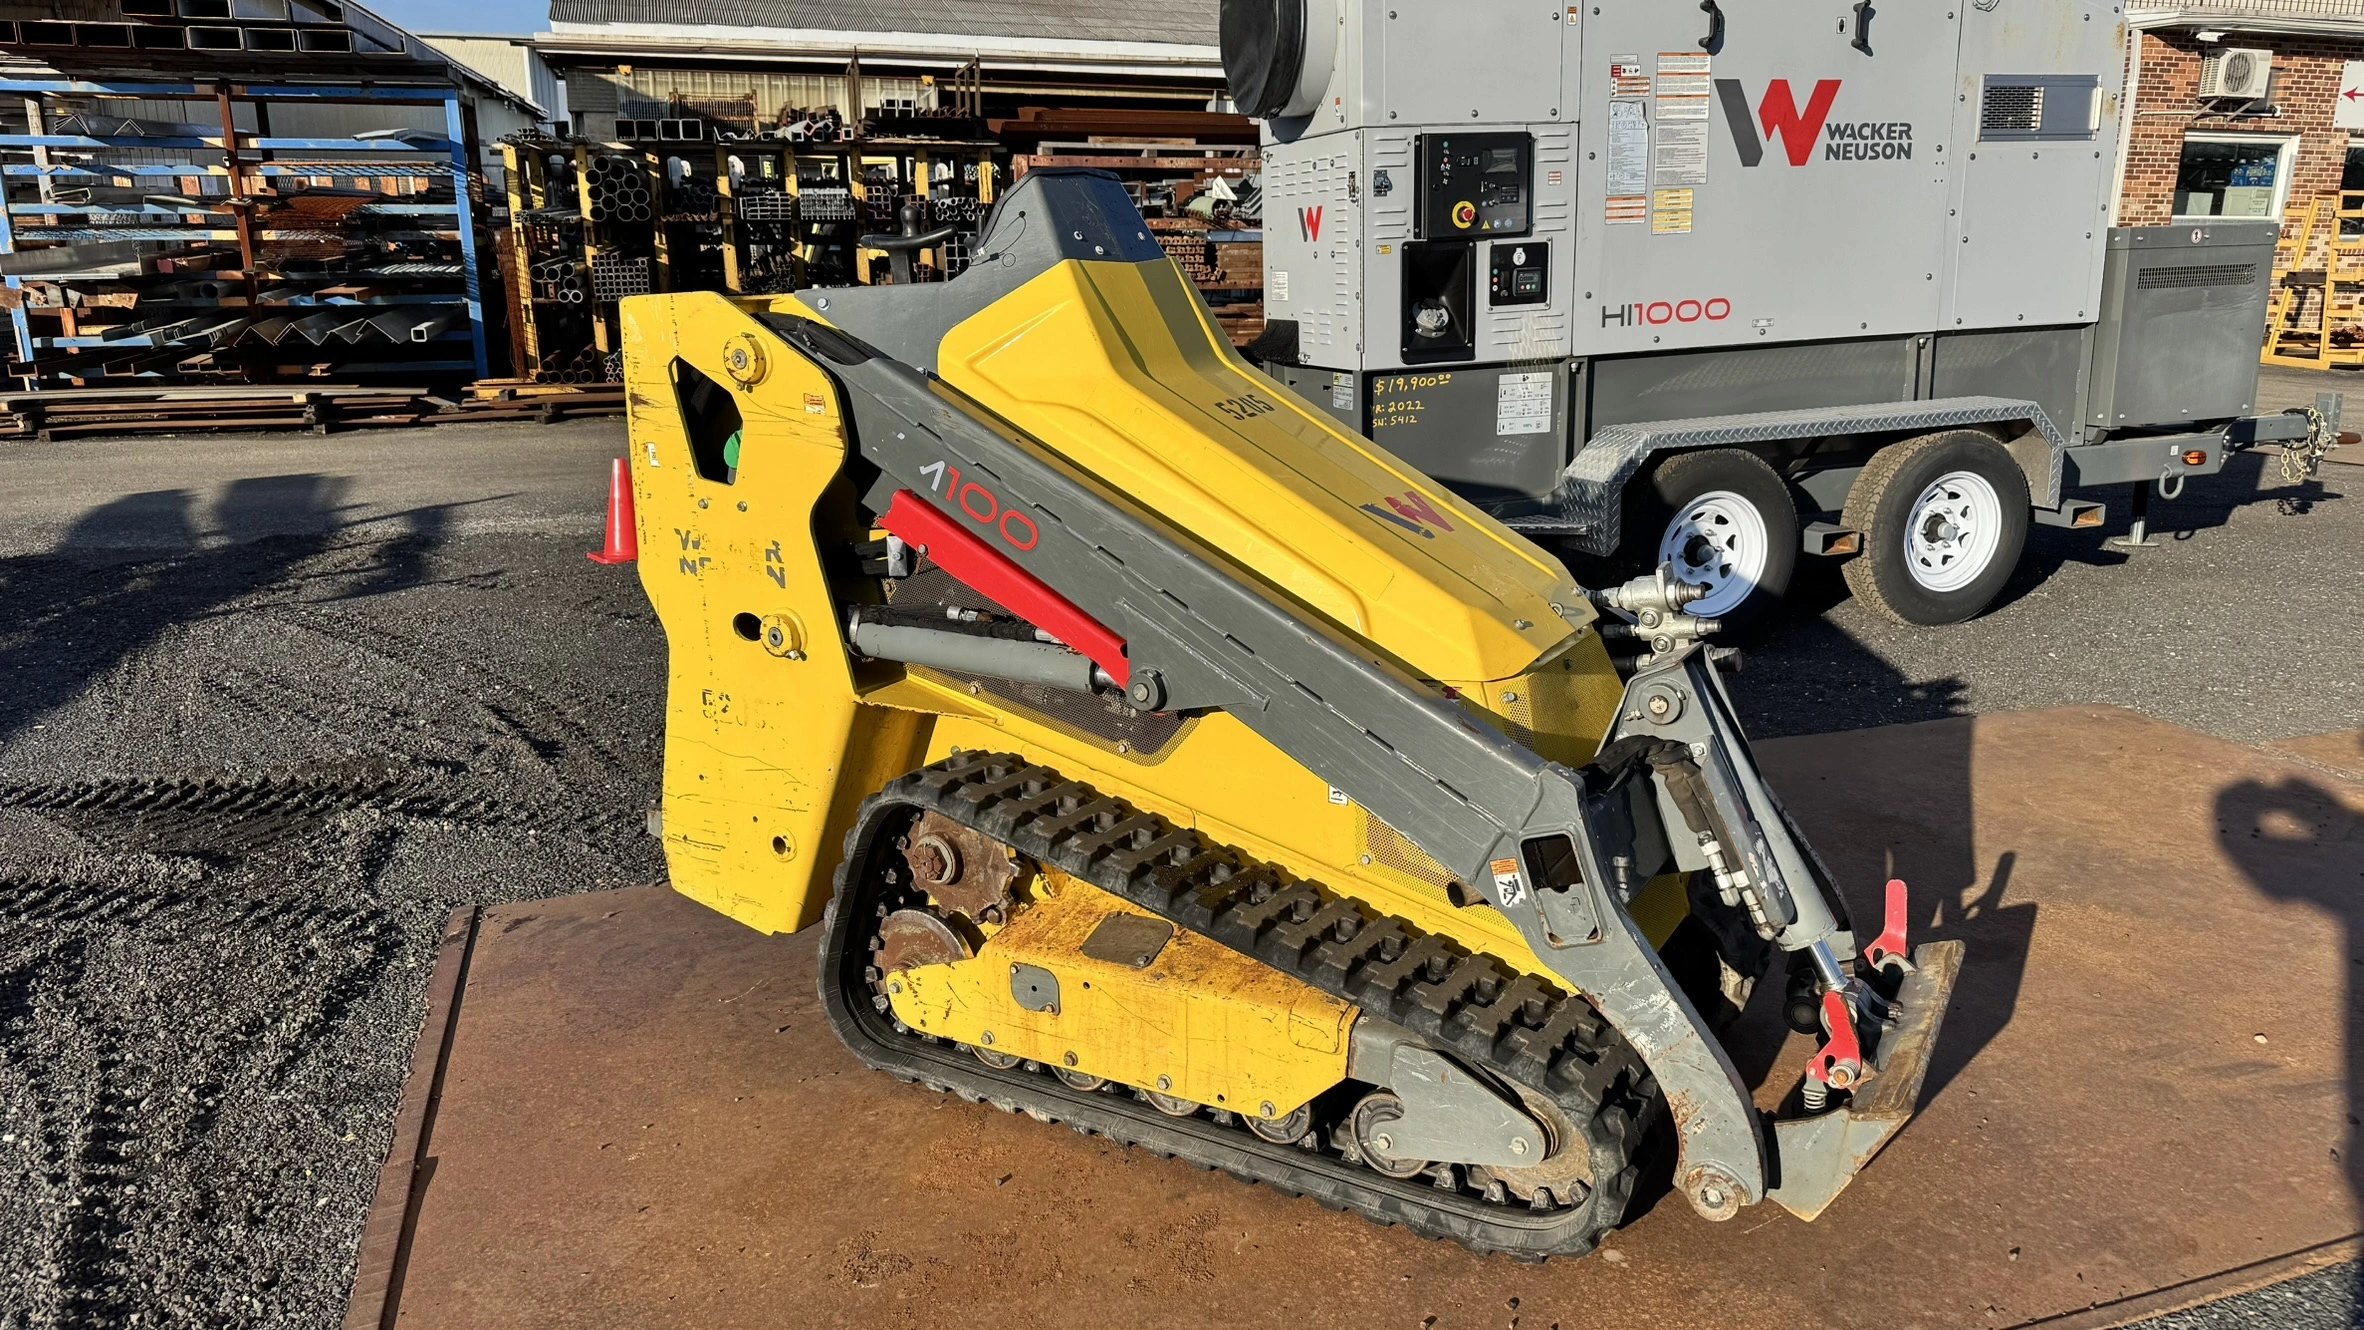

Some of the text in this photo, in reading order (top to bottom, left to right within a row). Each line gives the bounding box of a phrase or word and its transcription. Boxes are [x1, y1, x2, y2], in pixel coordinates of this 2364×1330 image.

[1825, 122, 1913, 141] WACKER
[1825, 142, 1913, 161] NEUSON
[1602, 298, 1731, 328] HI1000
[1388, 400, 1425, 413] 2022
[1372, 415, 1417, 428] SN: 5412
